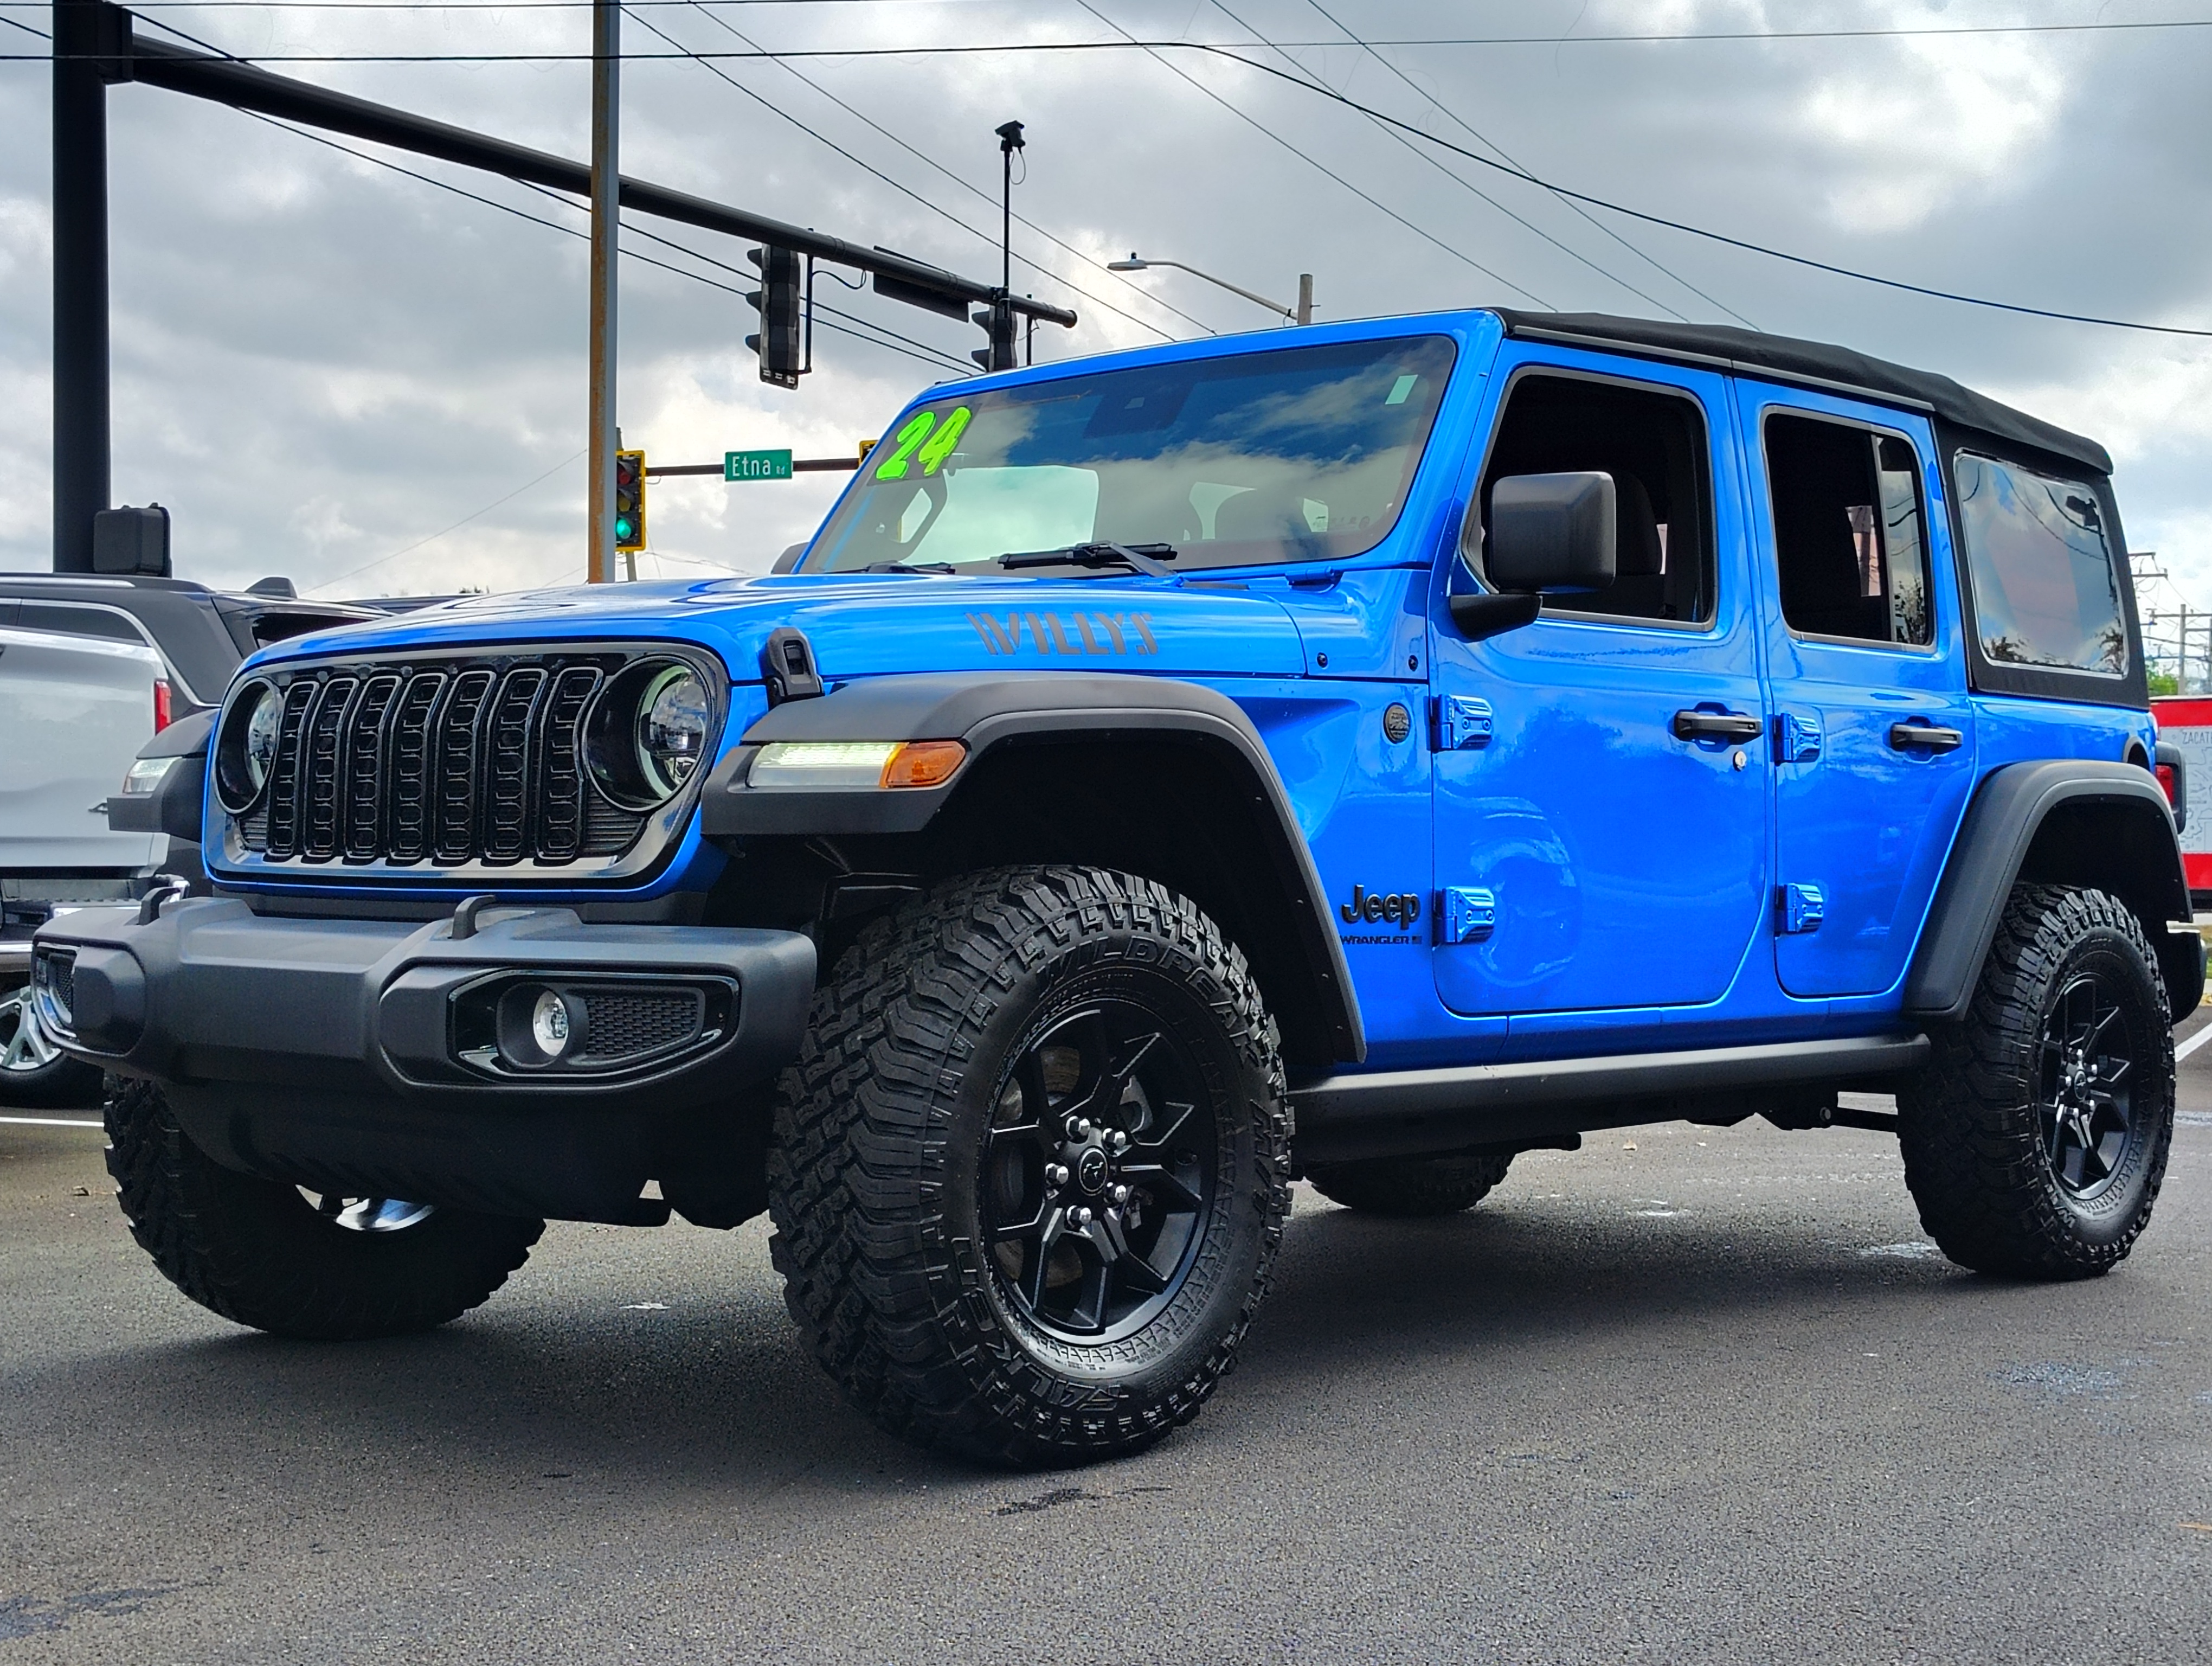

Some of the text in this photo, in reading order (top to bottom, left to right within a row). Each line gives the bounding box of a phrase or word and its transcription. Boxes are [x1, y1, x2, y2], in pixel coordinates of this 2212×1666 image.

[875, 406, 972, 480] 24
[732, 456, 771, 477] Etna
[964, 612, 1159, 655] WILLYS
[2182, 732, 2212, 745] ZACAT
[1341, 884, 1421, 931] Jeep
[1340, 935, 1409, 945] WRANGLER
[1036, 935, 1259, 1069] WILDPEAK
